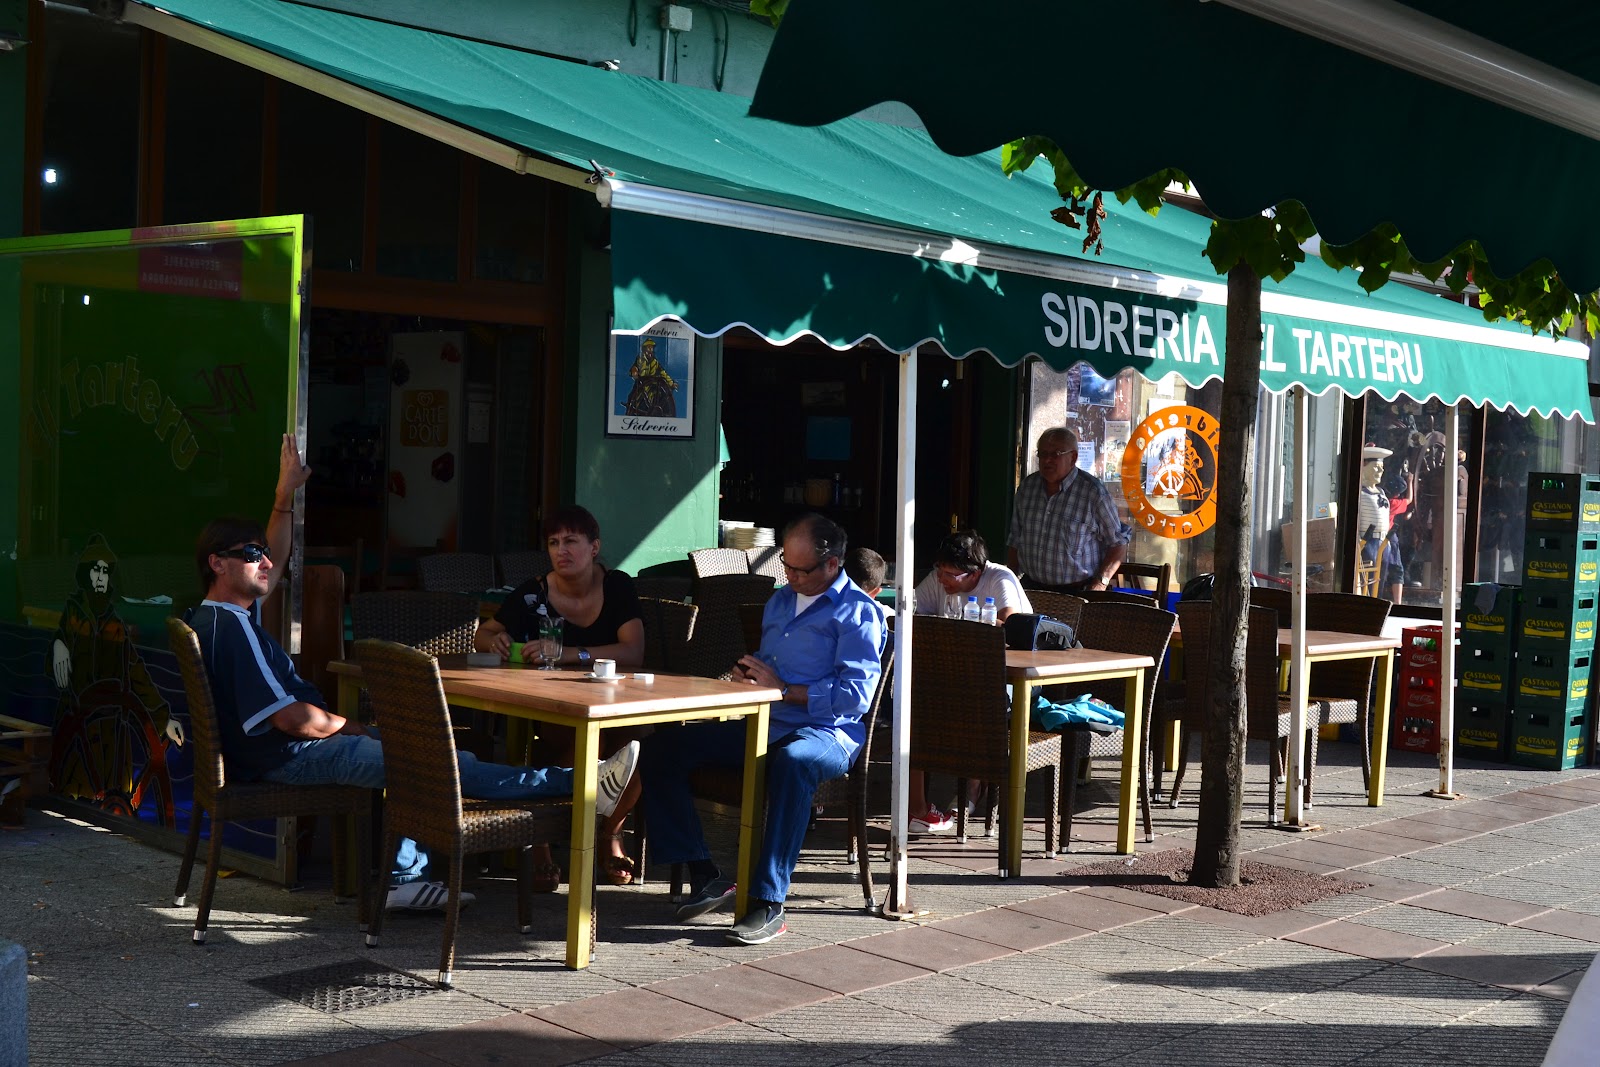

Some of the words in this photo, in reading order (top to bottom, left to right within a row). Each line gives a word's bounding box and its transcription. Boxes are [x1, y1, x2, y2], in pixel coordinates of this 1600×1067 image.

[1041, 292, 1220, 366] SIDRERIA
[1259, 323, 1287, 373] L
[1292, 328, 1425, 386] TARTERU
[60, 355, 200, 472] Tarteru
[404, 403, 447, 425] CARTE
[409, 423, 442, 445] D'OR
[621, 416, 679, 434] Sidreria
